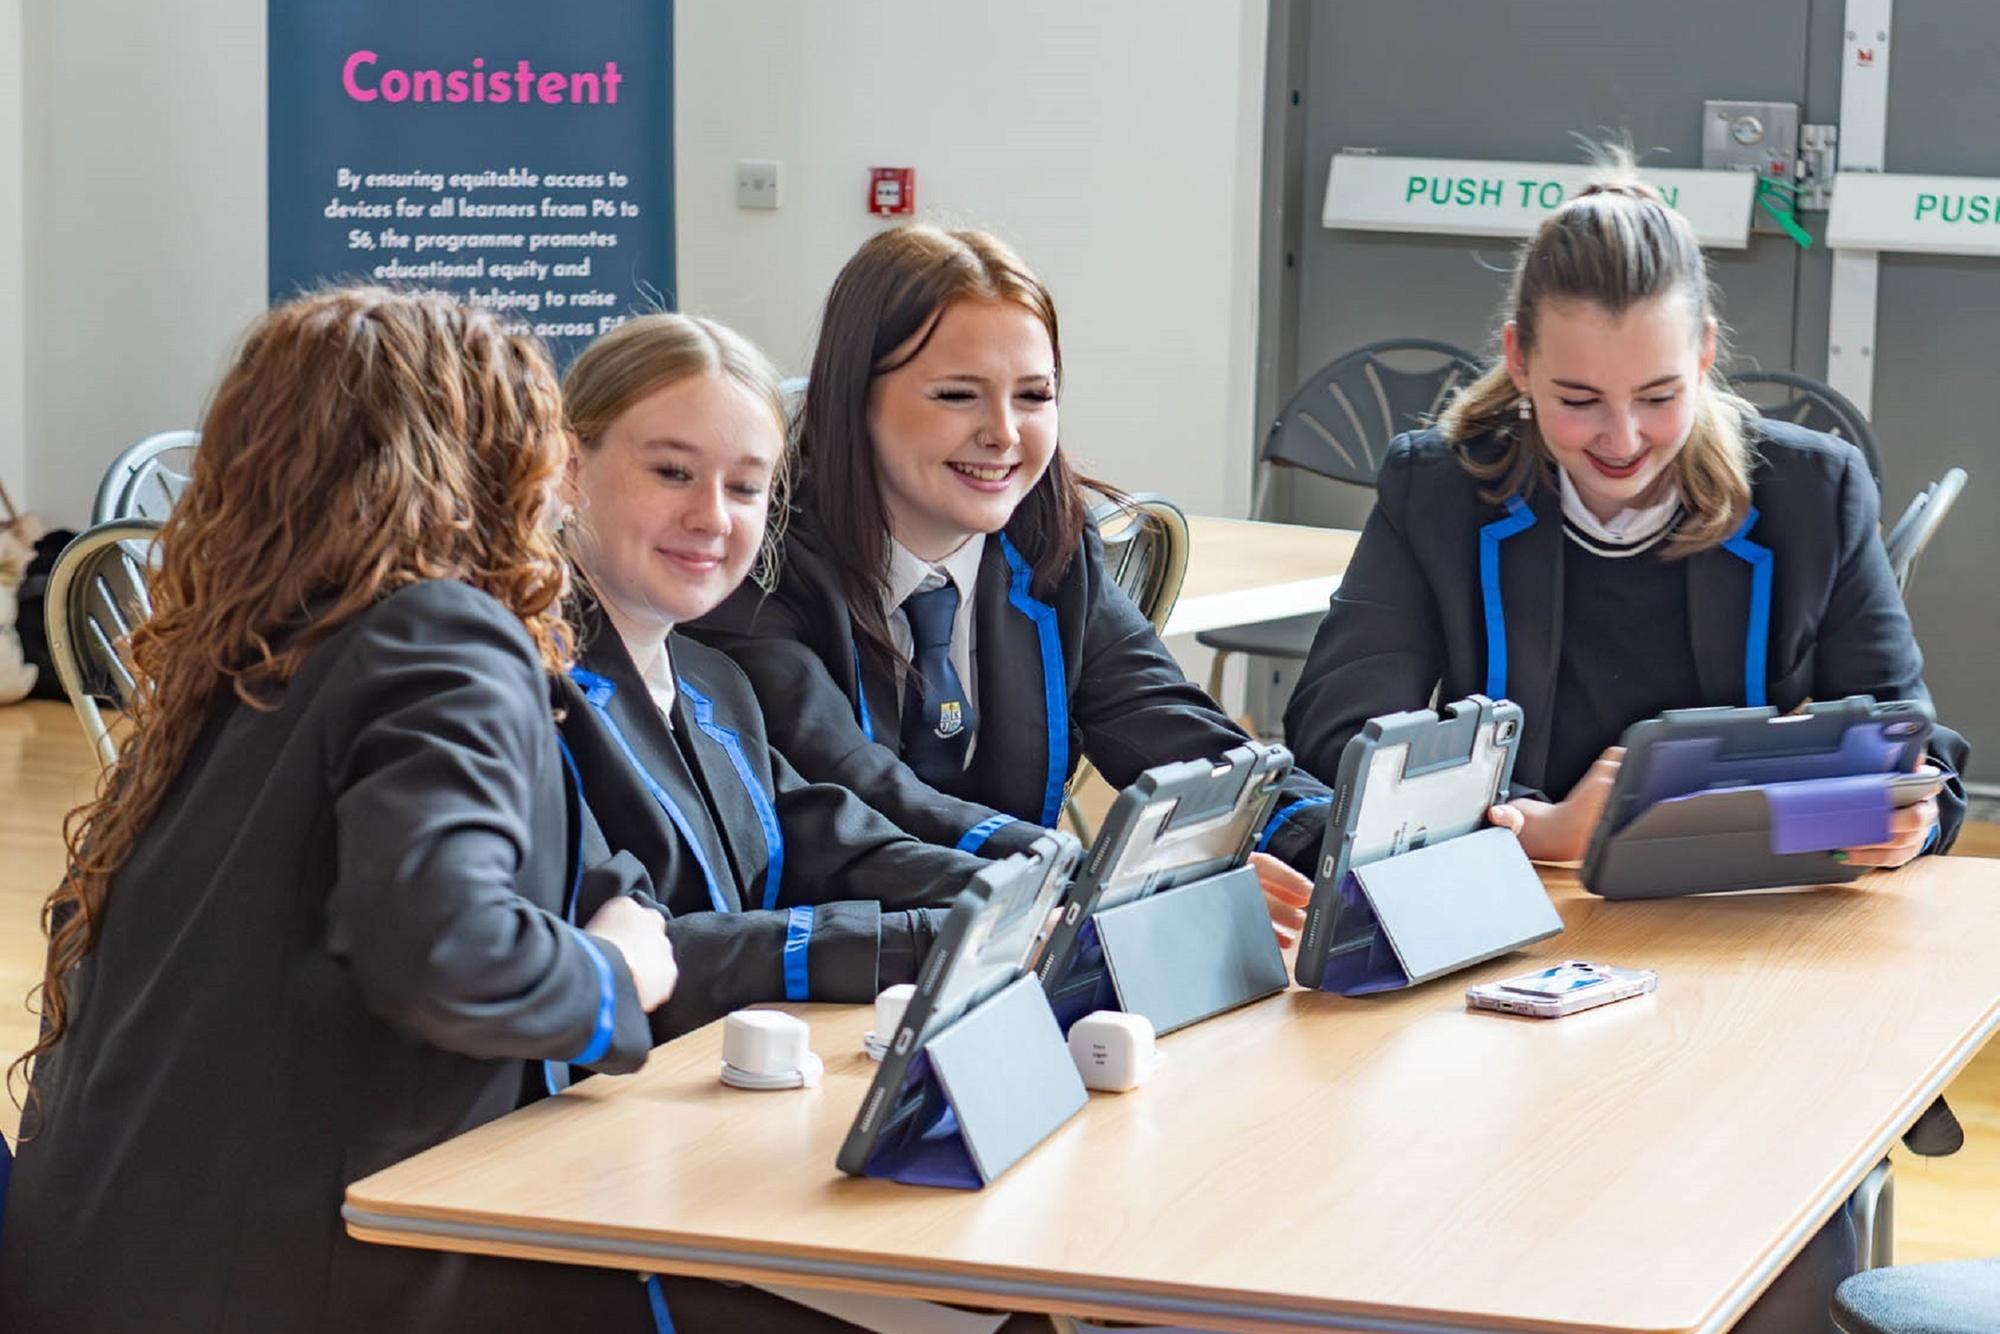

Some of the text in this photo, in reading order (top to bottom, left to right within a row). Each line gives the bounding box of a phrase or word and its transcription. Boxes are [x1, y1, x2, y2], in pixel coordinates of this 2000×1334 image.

[342, 50, 623, 104] Consistent
[337, 168, 628, 192] By ensuring equitable access to
[1405, 176, 1564, 209] PUSH TO
[324, 197, 639, 218] devices for all learners from P6 to
[348, 228, 617, 252] S6, the programme promotes
[373, 256, 591, 281] educational equity and
[469, 287, 540, 312] helping
[545, 290, 566, 307] to
[569, 289, 617, 306] raise
[534, 323, 595, 336] across
